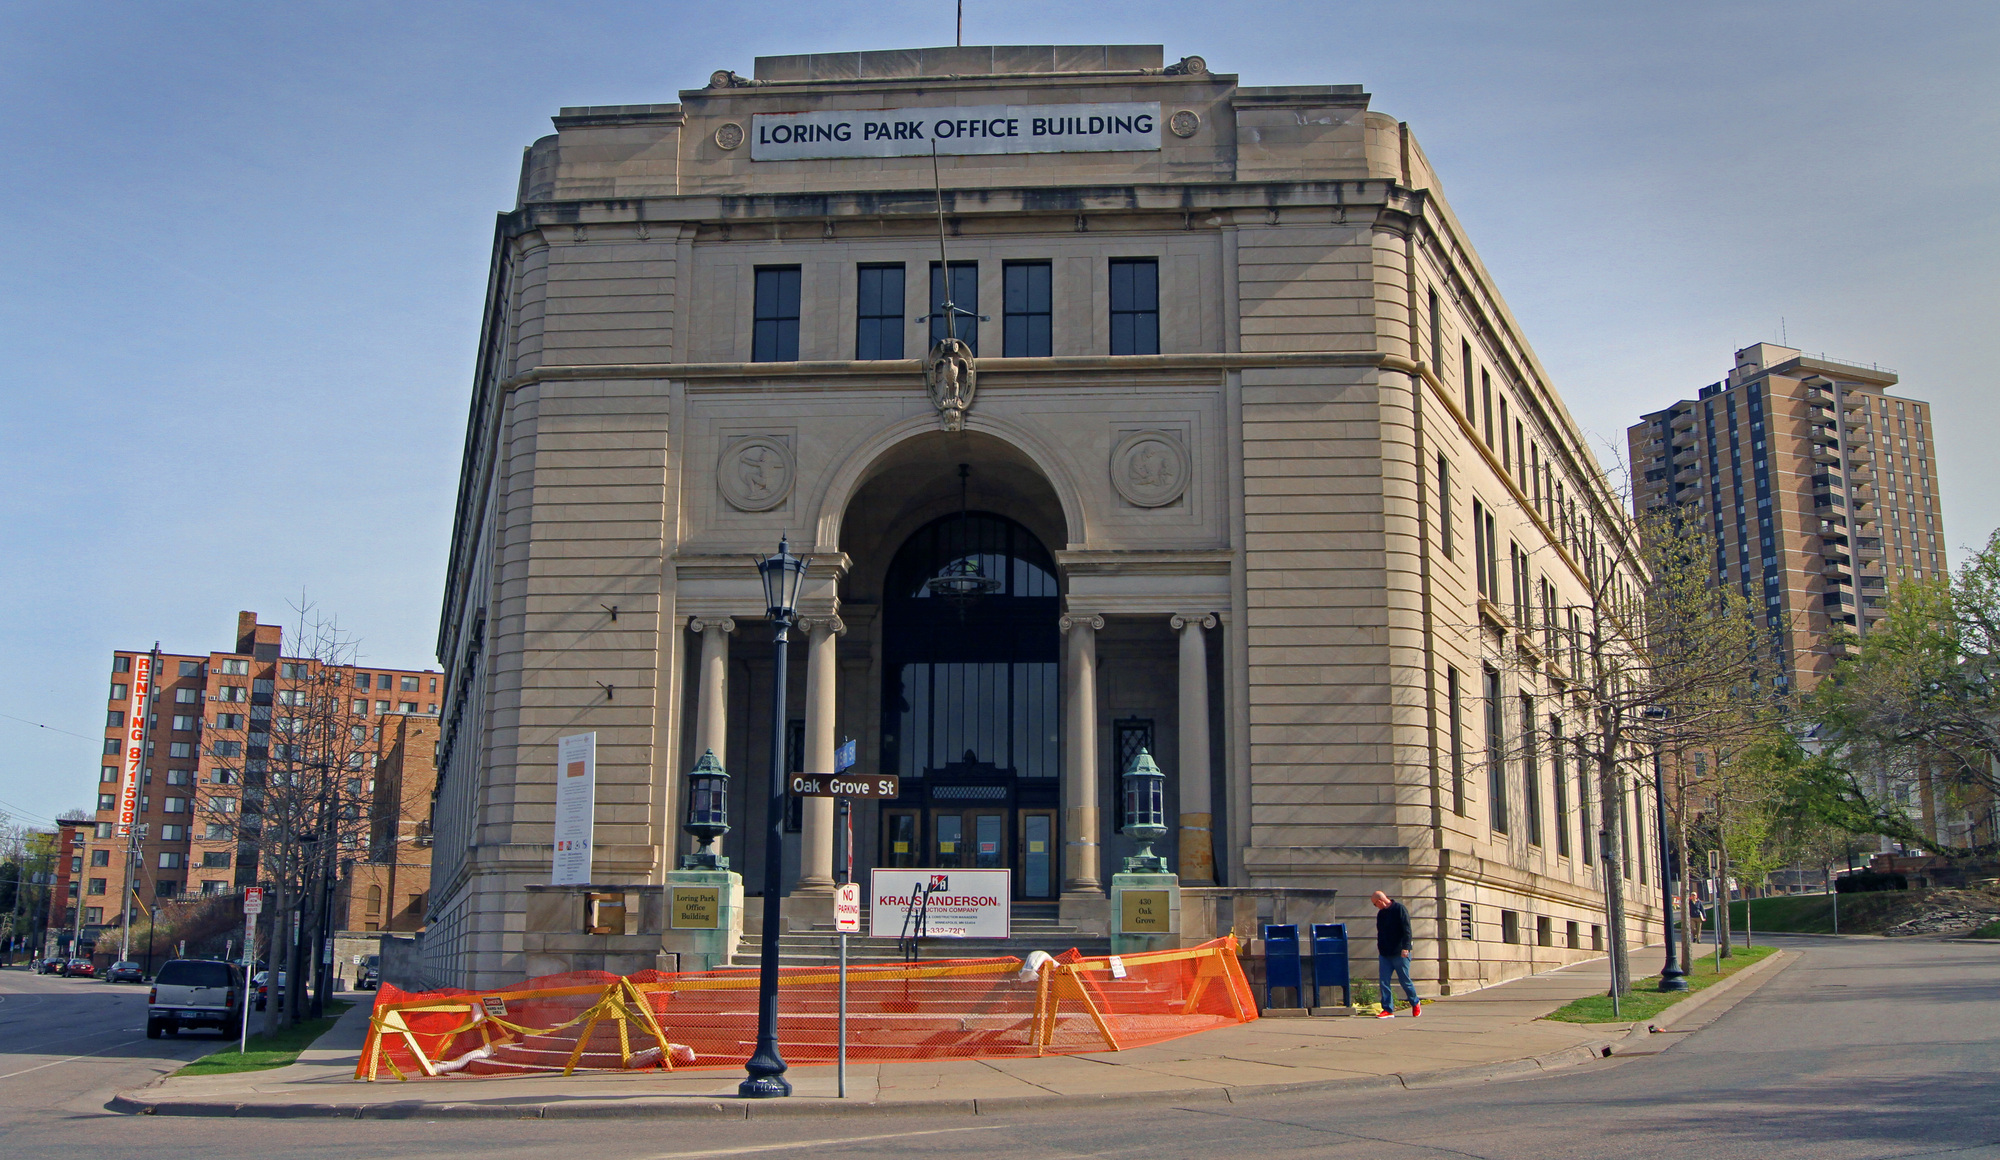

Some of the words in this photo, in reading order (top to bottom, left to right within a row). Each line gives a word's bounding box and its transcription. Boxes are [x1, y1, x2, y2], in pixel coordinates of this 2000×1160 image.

[760, 122, 851, 144] LORING
[864, 121, 924, 140] PARK
[934, 118, 1019, 139] OFFICE
[1032, 114, 1153, 136] BUILDING
[131, 658, 150, 741] RENTING
[793, 777, 820, 793] Oak
[830, 778, 869, 794] Grove
[878, 780, 894, 795] St
[676, 894, 698, 902] Loring
[700, 894, 715, 902] Park
[843, 890, 853, 901] NO
[927, 896, 997, 906] ANDERSON
[838, 904, 858, 914] PARKING
[1138, 907, 1152, 915] Oak
[681, 912, 709, 921] Building
[1135, 916, 1155, 924] Grove
